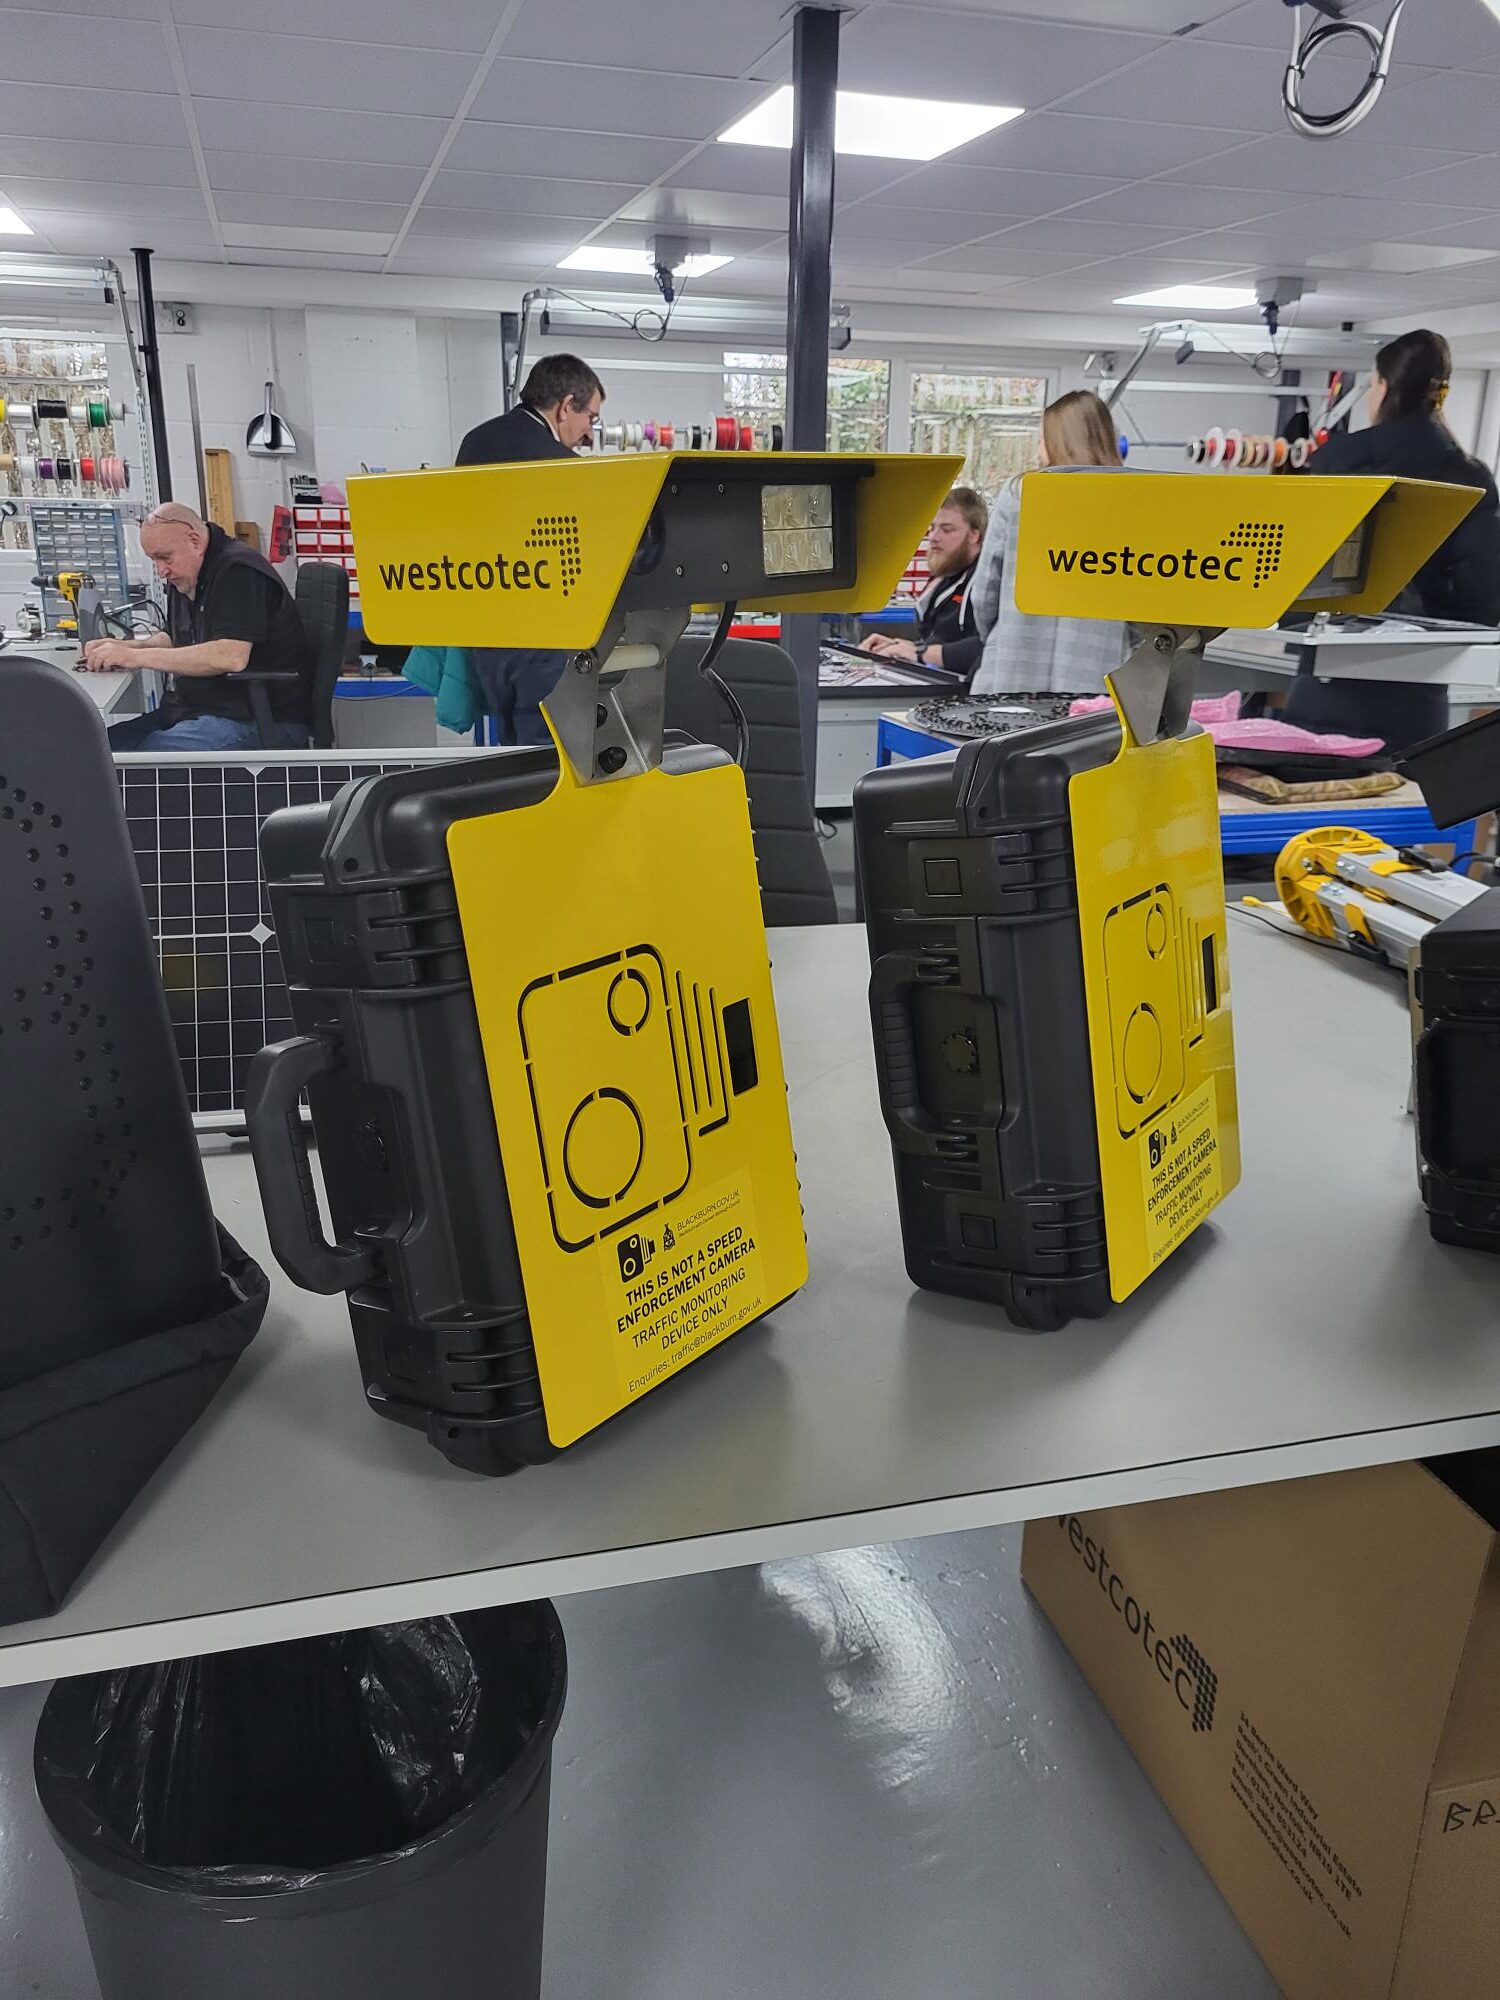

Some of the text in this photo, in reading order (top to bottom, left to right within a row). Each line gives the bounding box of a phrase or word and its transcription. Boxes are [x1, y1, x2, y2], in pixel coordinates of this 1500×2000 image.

[379, 553, 551, 591] westcotec
[1048, 546, 1243, 581] westcotec
[1147, 1138, 1217, 1212] ENFORCEMENT CAMERA
[1152, 1128, 1211, 1189] THIS IS NOT A SPEED
[1155, 1195, 1179, 1226] TRAFFIC
[1178, 1163, 1212, 1202] MONITORING
[1169, 1186, 1203, 1228] DEVICE ONLY
[617, 1237, 756, 1334] ENFORCEMENT CAMERA
[625, 1226, 743, 1306] THIS IS NOT A SPEED
[632, 1267, 746, 1348] TRAFFIC MONITORING
[661, 1296, 729, 1350] DEVICE ONLY
[628, 1296, 762, 1393] Enquiries: traffic@blackburn.gov.uk
[1290, 1795, 1331, 1855] Industrial
